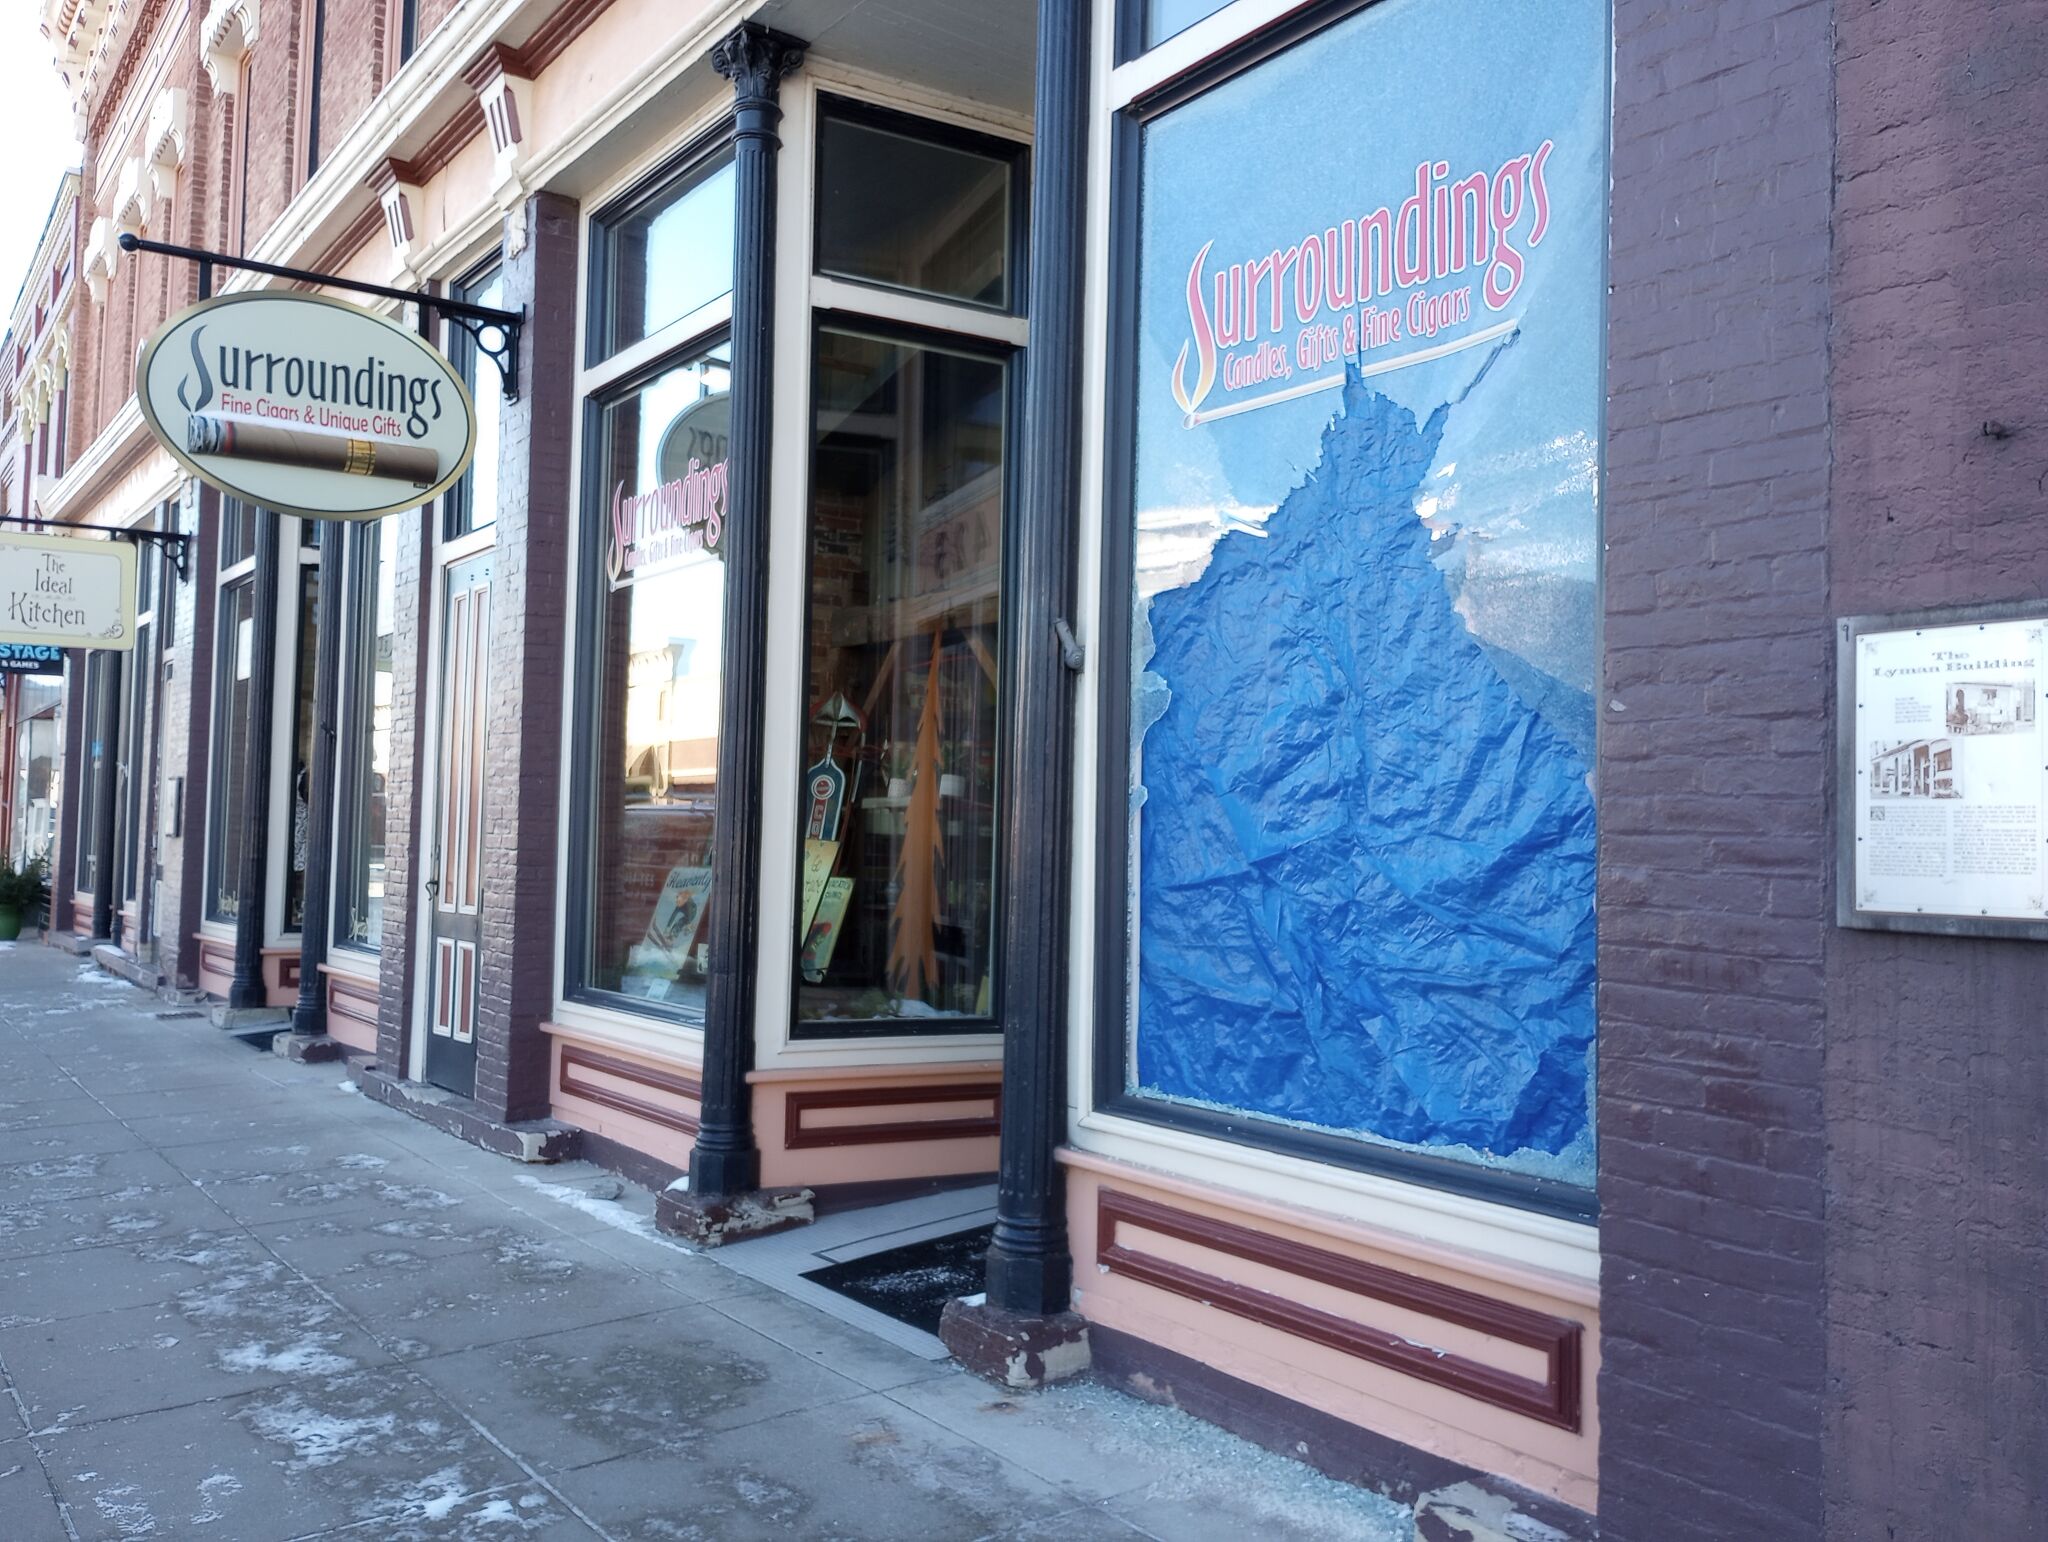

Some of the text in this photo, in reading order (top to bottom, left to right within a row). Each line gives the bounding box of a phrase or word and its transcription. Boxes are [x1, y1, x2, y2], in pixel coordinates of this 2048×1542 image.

[1172, 139, 1554, 413] Surroundings
[1223, 286, 1471, 392] Candles, Gifts & Fine Cigars
[177, 324, 442, 440] Surroundings
[221, 393, 252, 414] Fine
[303, 405, 316, 424] &
[320, 408, 369, 433] Unique
[373, 415, 402, 438] Gifts
[607, 457, 728, 582] Surroundings
[35, 569, 72, 594] Ideal
[42, 553, 66, 574] The
[8, 592, 85, 629] Kitchen
[10, 660, 40, 669] GAMES
